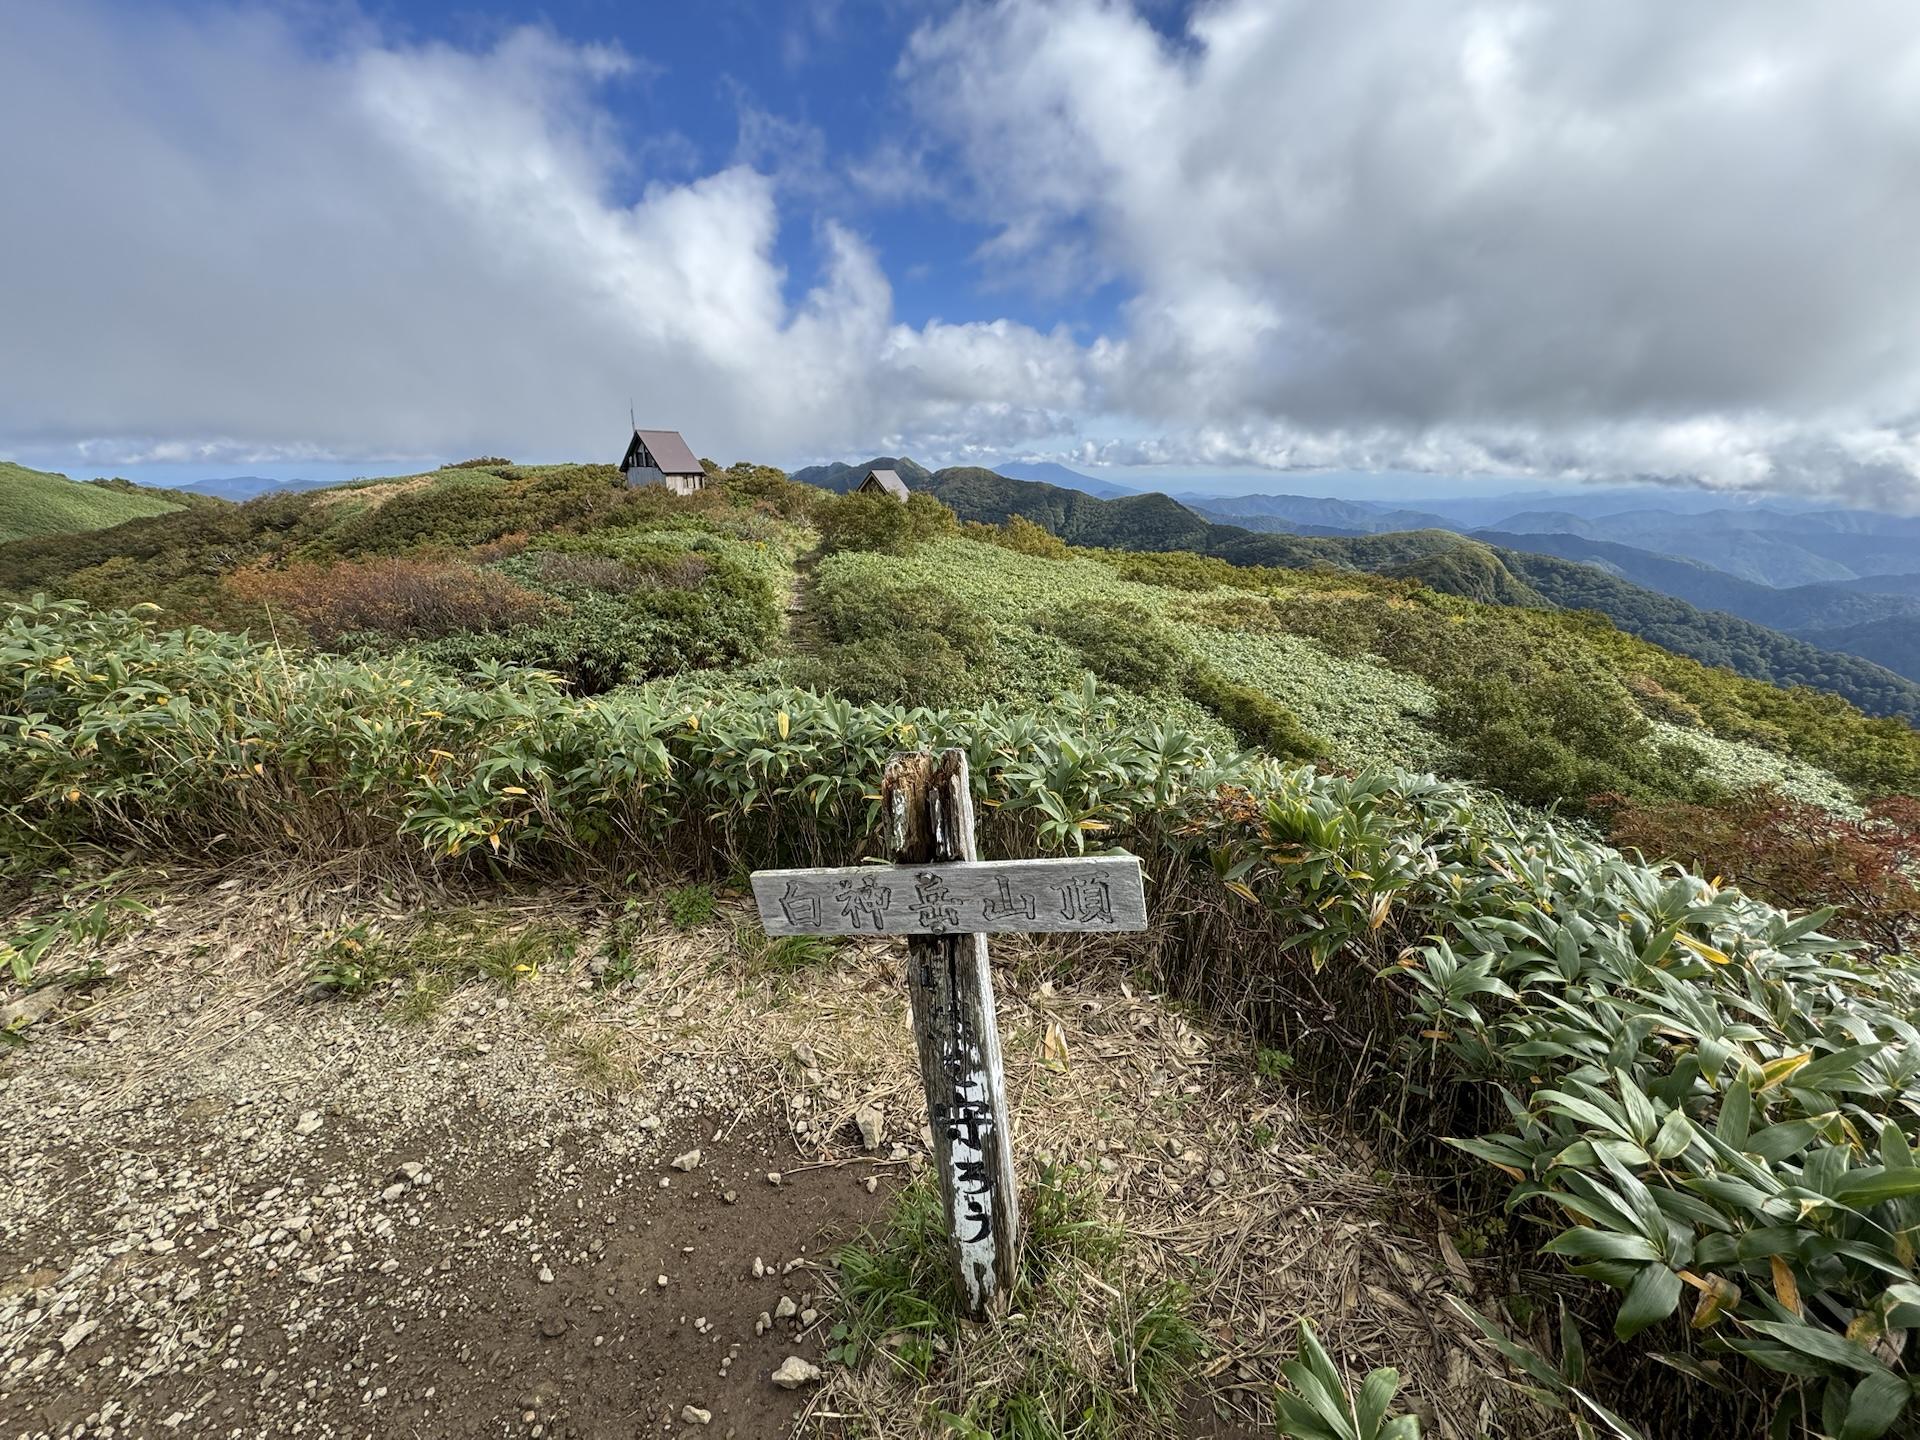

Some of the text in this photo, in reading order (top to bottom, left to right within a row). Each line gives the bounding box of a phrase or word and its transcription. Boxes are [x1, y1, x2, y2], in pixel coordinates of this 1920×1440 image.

[778, 873, 1113, 932] 白神岳山頂
